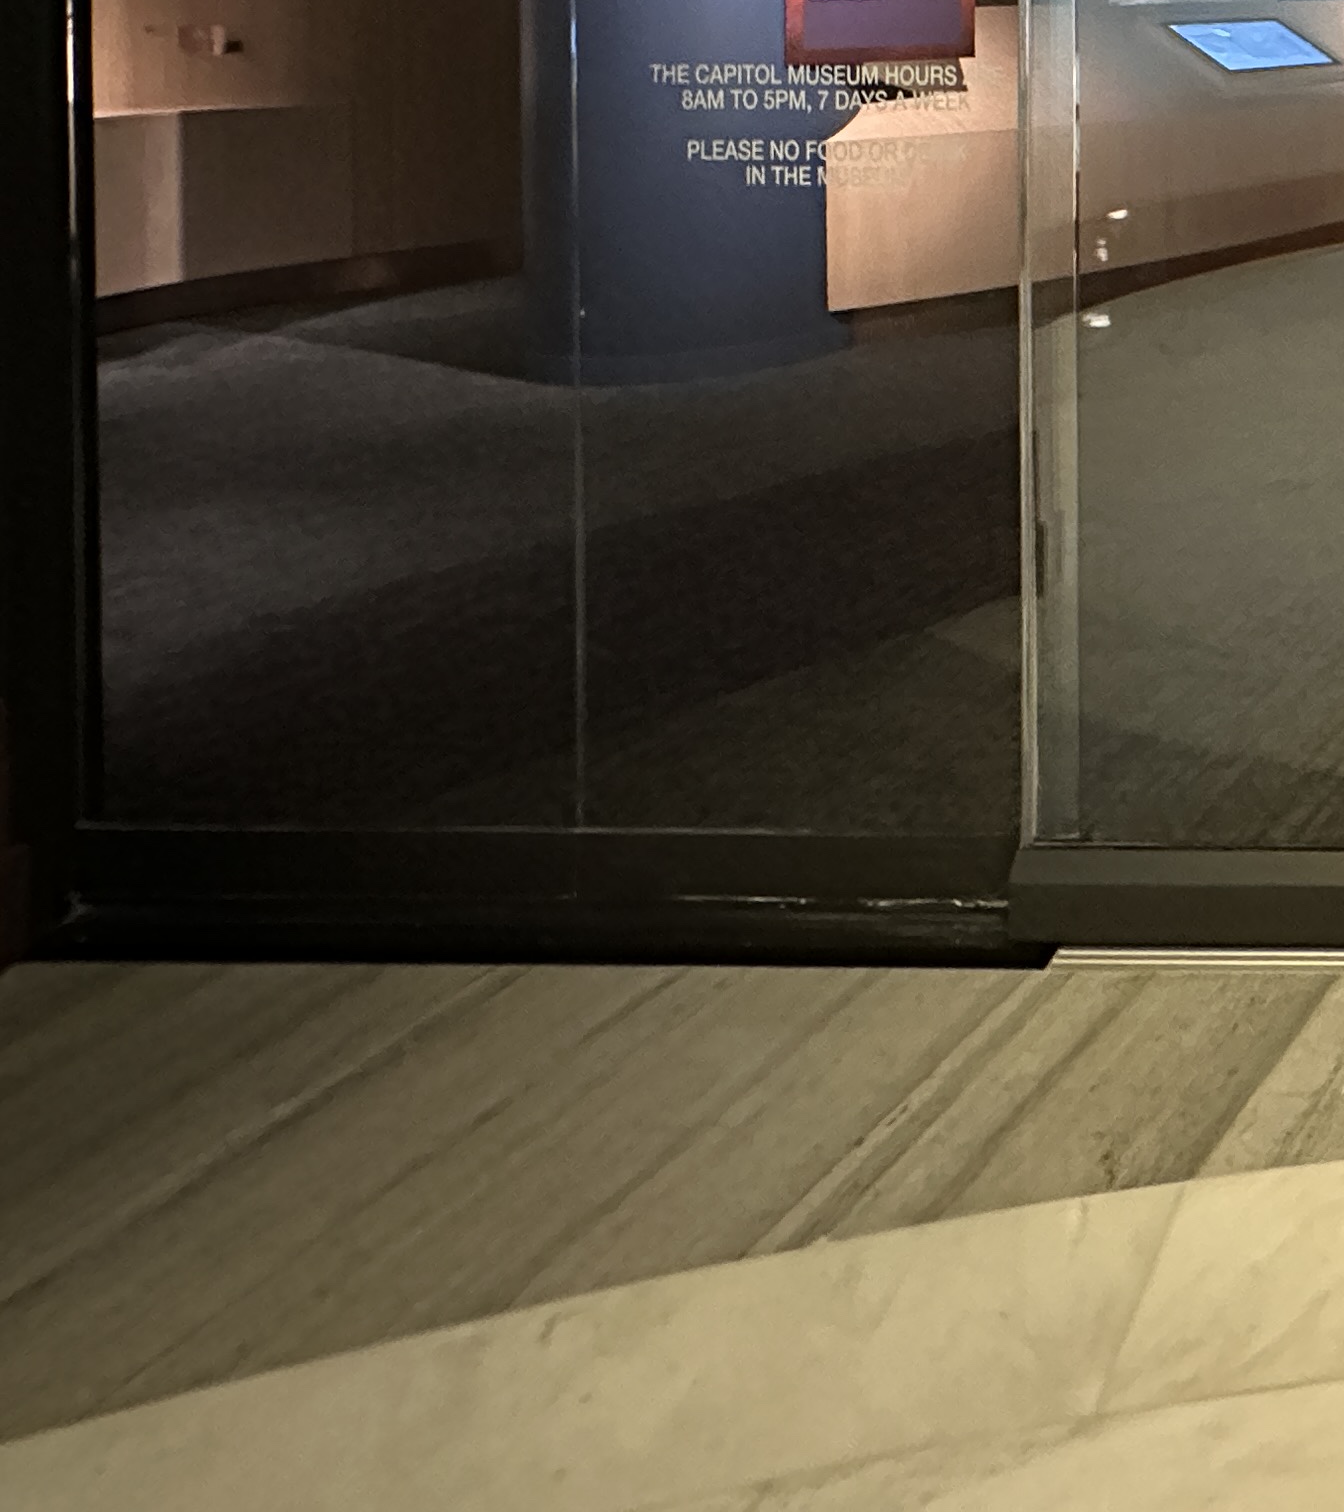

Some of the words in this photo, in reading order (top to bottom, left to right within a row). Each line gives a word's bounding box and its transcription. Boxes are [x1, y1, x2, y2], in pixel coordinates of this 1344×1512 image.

[650, 63, 690, 85] THE
[695, 63, 782, 85] CAPITOL
[787, 64, 879, 86] MUSEUM
[681, 89, 725, 110] 8AM
[729, 89, 758, 110] TO
[763, 89, 812, 114] 5PM,
[818, 89, 829, 111] 7
[835, 90, 888, 111] DAYS
[894, 90, 908, 111] A
[911, 90, 971, 111] WEEK
[687, 140, 764, 161] PLEASE
[769, 140, 799, 161] NO
[805, 140, 862, 162] FOOD
[746, 165, 766, 186] IN
[770, 165, 812, 186] THE
